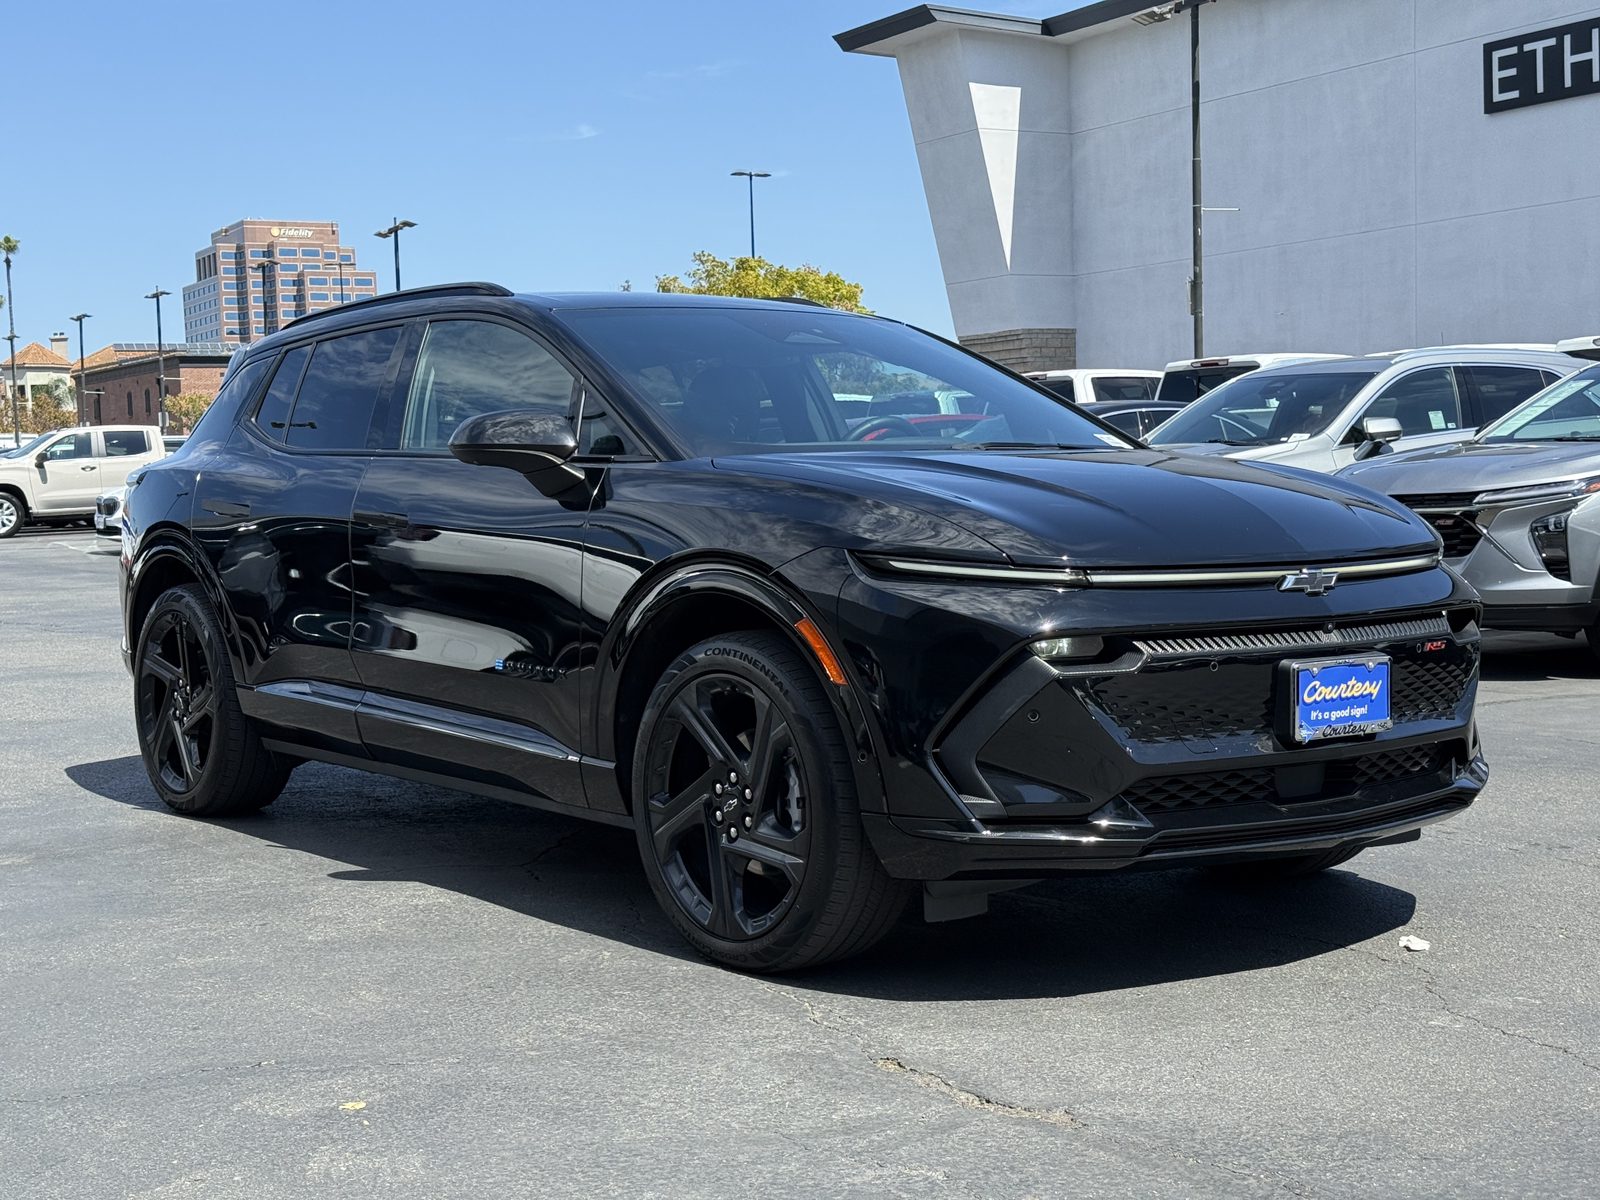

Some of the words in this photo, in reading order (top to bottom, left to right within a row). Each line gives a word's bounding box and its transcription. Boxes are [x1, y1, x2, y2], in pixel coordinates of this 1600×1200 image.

[1491, 27, 1600, 103] ETH
[280, 228, 313, 237] Fidelity
[703, 647, 790, 697] CONTINENTAL
[1303, 676, 1382, 704] Courtesy
[1310, 709, 1322, 721] It's
[1323, 711, 1330, 719] a
[1330, 706, 1350, 721] good
[1350, 704, 1368, 718] sign!
[1322, 721, 1369, 738] Courtesy
